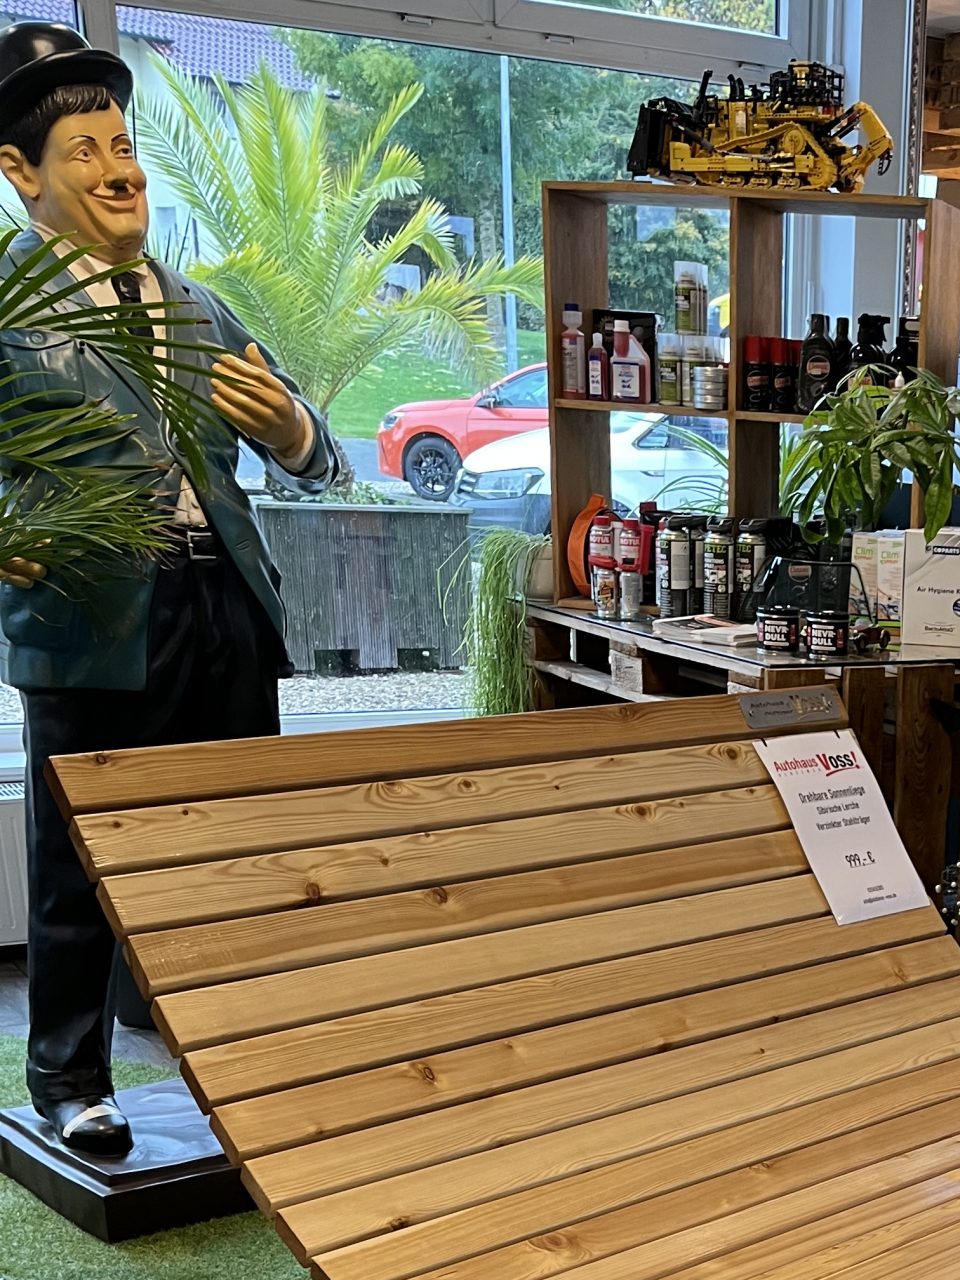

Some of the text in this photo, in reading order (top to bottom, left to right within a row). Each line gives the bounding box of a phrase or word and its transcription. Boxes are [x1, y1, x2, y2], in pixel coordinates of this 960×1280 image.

[928, 586, 955, 595] Hygiene
[764, 632, 787, 642] DULL
[811, 637, 833, 646] DULL
[773, 758, 819, 773] Autohaus
[815, 751, 860, 771] Voss!
[799, 791, 828, 803] Drehbare
